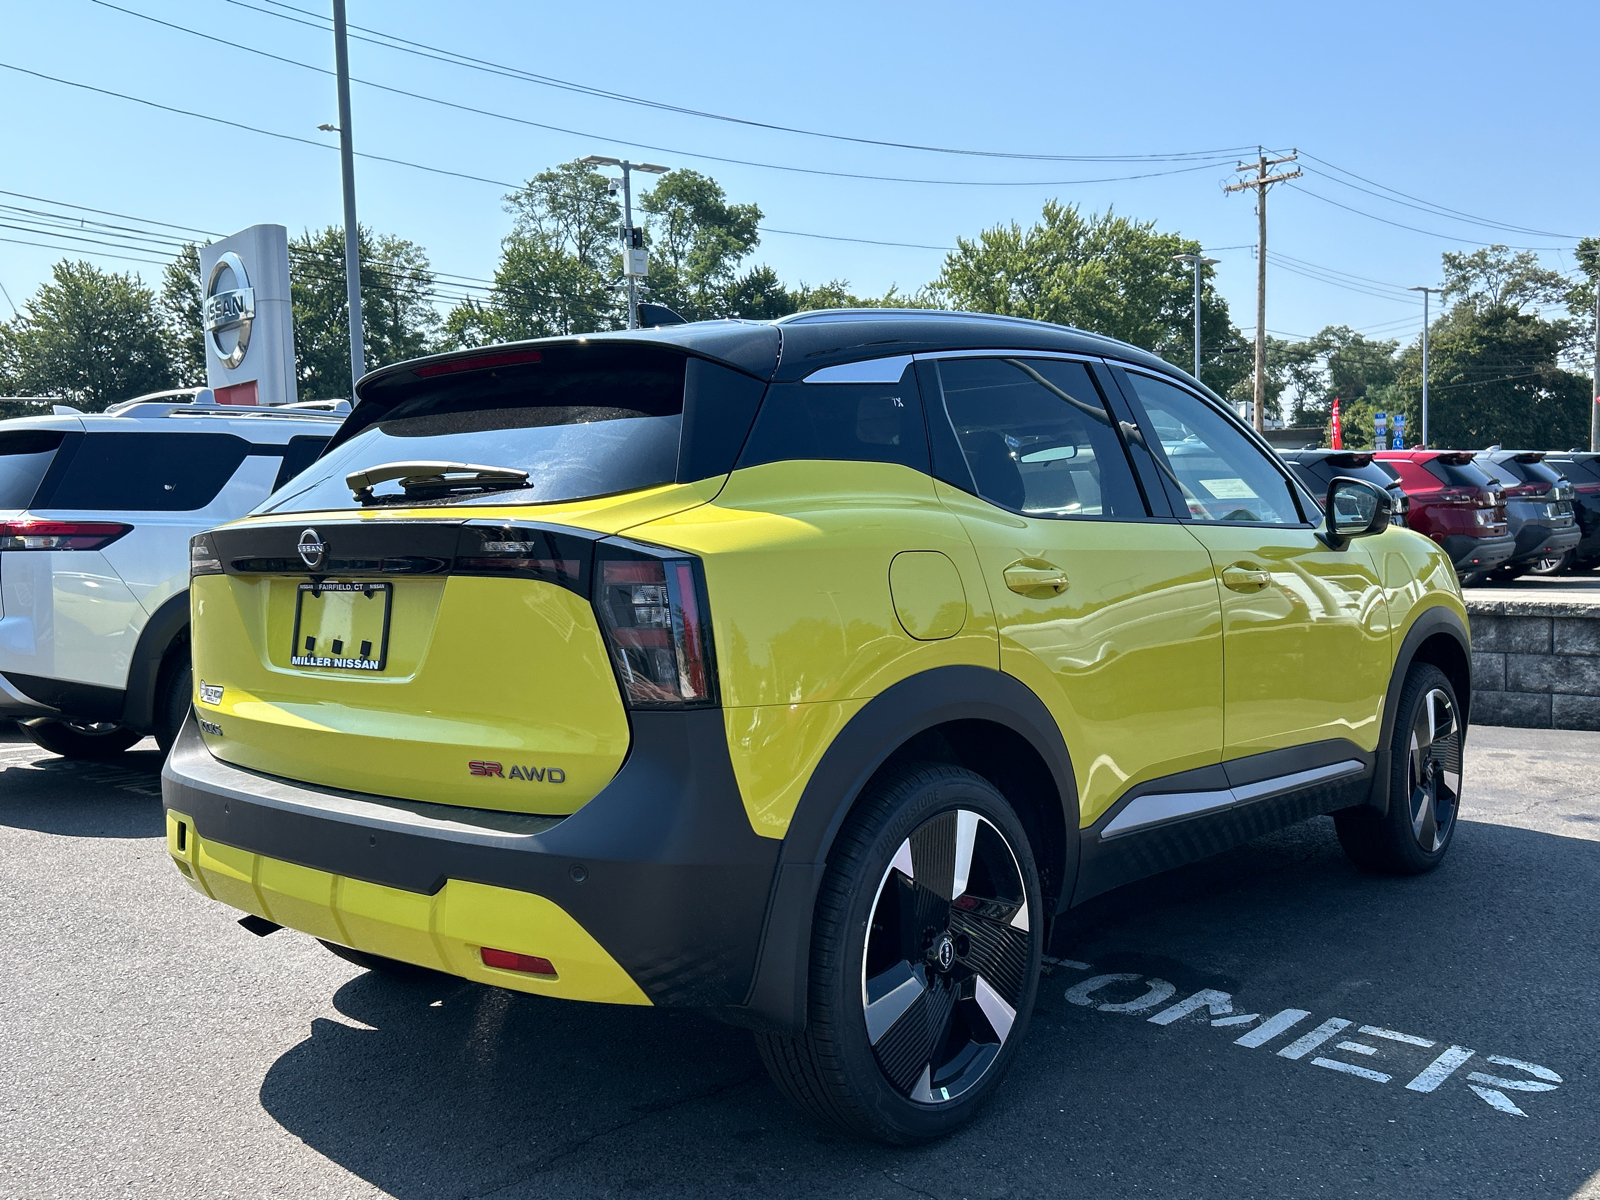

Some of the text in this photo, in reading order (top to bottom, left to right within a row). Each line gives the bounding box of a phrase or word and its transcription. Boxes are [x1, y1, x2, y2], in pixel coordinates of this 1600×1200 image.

[1376, 427, 1385, 435] 95
[1394, 430, 1403, 438] 95
[292, 656, 379, 670] MILLER NISSAN
[468, 760, 566, 784] SR AWD
